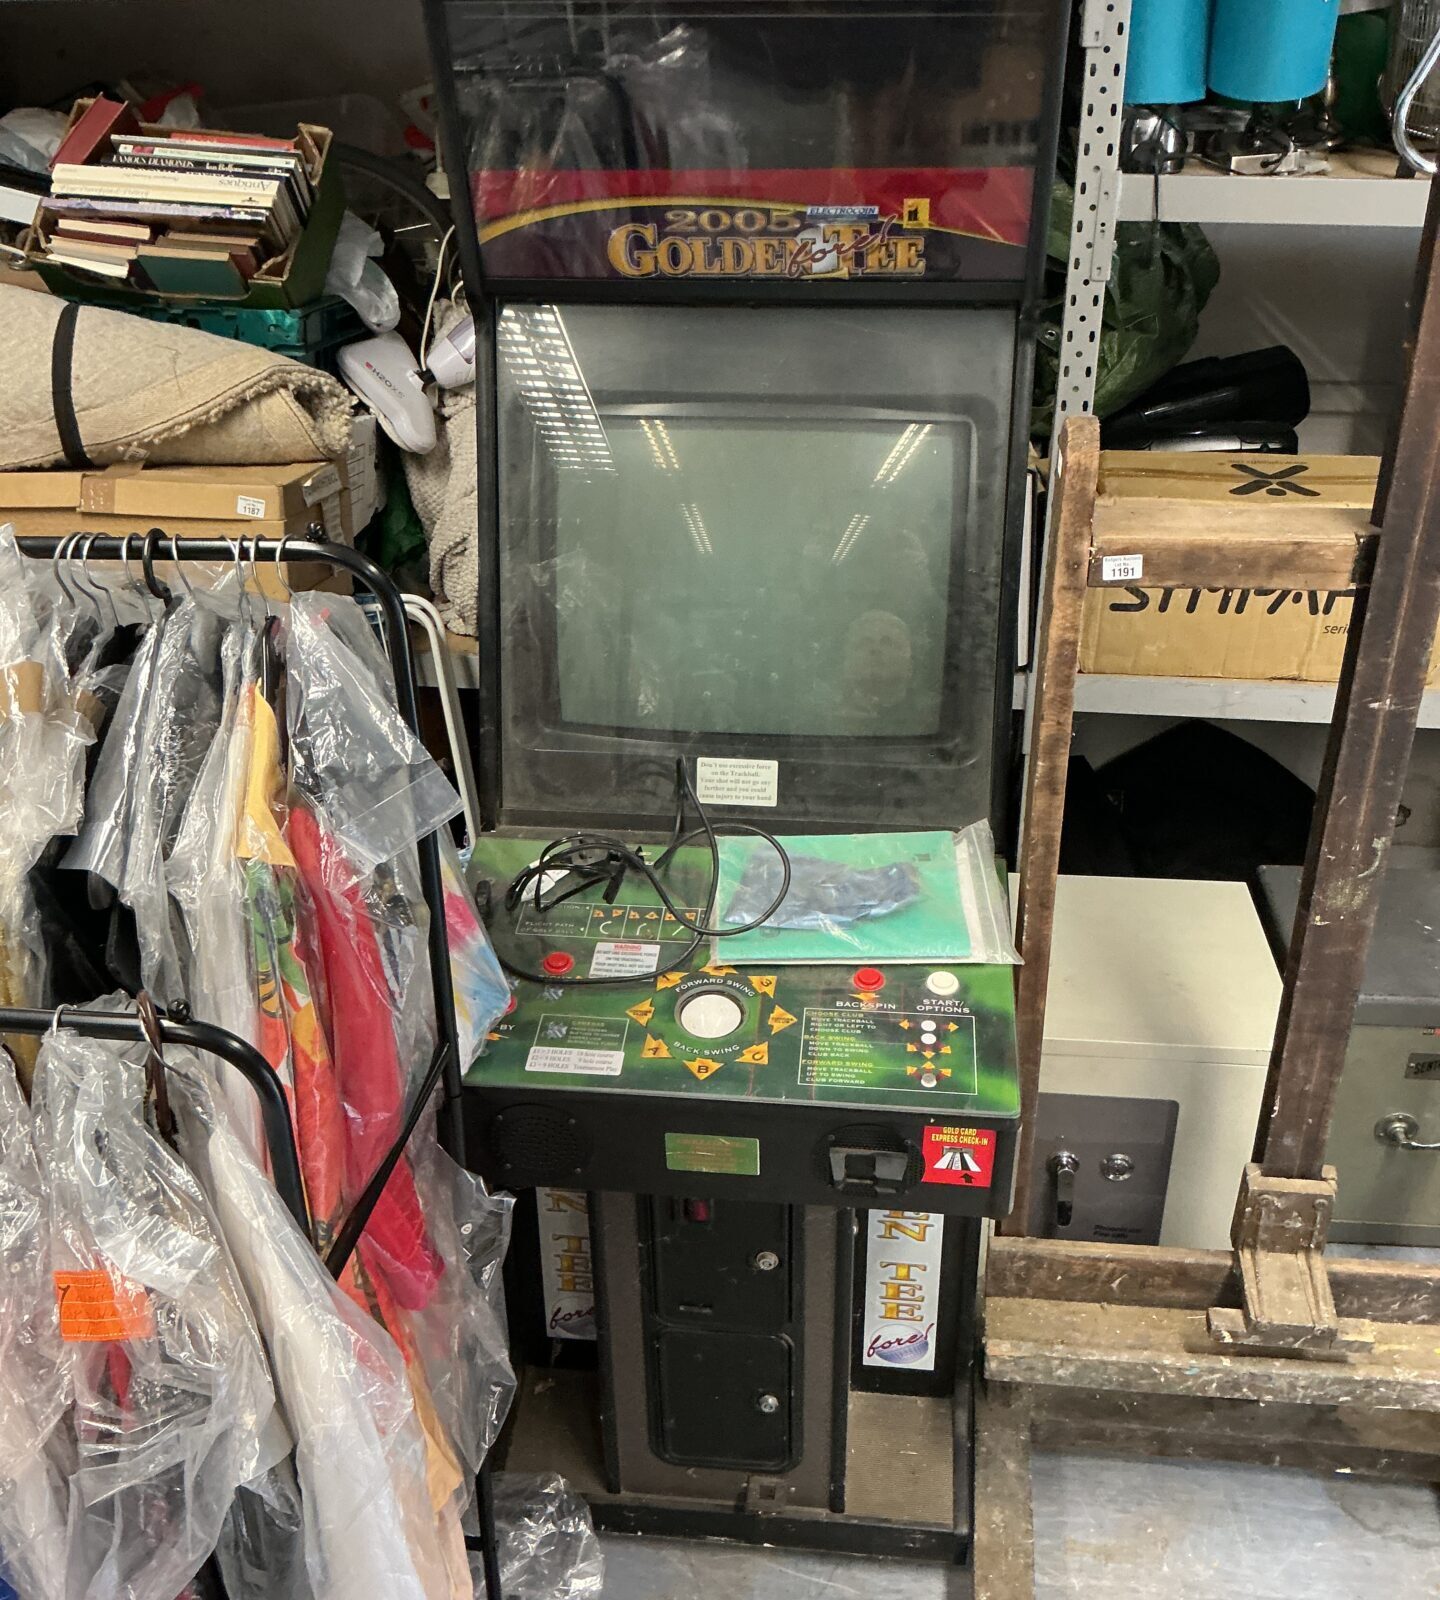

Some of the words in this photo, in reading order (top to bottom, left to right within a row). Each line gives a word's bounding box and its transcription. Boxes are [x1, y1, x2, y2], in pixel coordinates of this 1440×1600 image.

[148, 157, 195, 168] DIAMONDS
[218, 177, 273, 192] Antiques
[664, 209, 801, 232] 2005
[607, 223, 816, 278] GOLDEN
[821, 224, 926, 277] TEE
[243, 506, 260, 516] 1187
[1112, 567, 1135, 577] 1191
[675, 978, 724, 993] FORWARD
[726, 980, 756, 997] SWING
[760, 978, 772, 987] 3
[835, 1001, 896, 1010] BACKSPIN
[922, 999, 964, 1007] START/
[916, 1006, 970, 1014] OPTIONS
[648, 1046, 659, 1056] A
[673, 1041, 700, 1055] BACK
[704, 1044, 741, 1056] SWING
[752, 1051, 764, 1061] C
[697, 1065, 708, 1073] B
[942, 1126, 959, 1135] GOLD
[960, 1128, 977, 1136] CARD
[931, 1133, 958, 1143] EXPRESS
[959, 1136, 989, 1146] CHECK-IN
[879, 1261, 927, 1321] TEE
[867, 1323, 935, 1358] fore!
